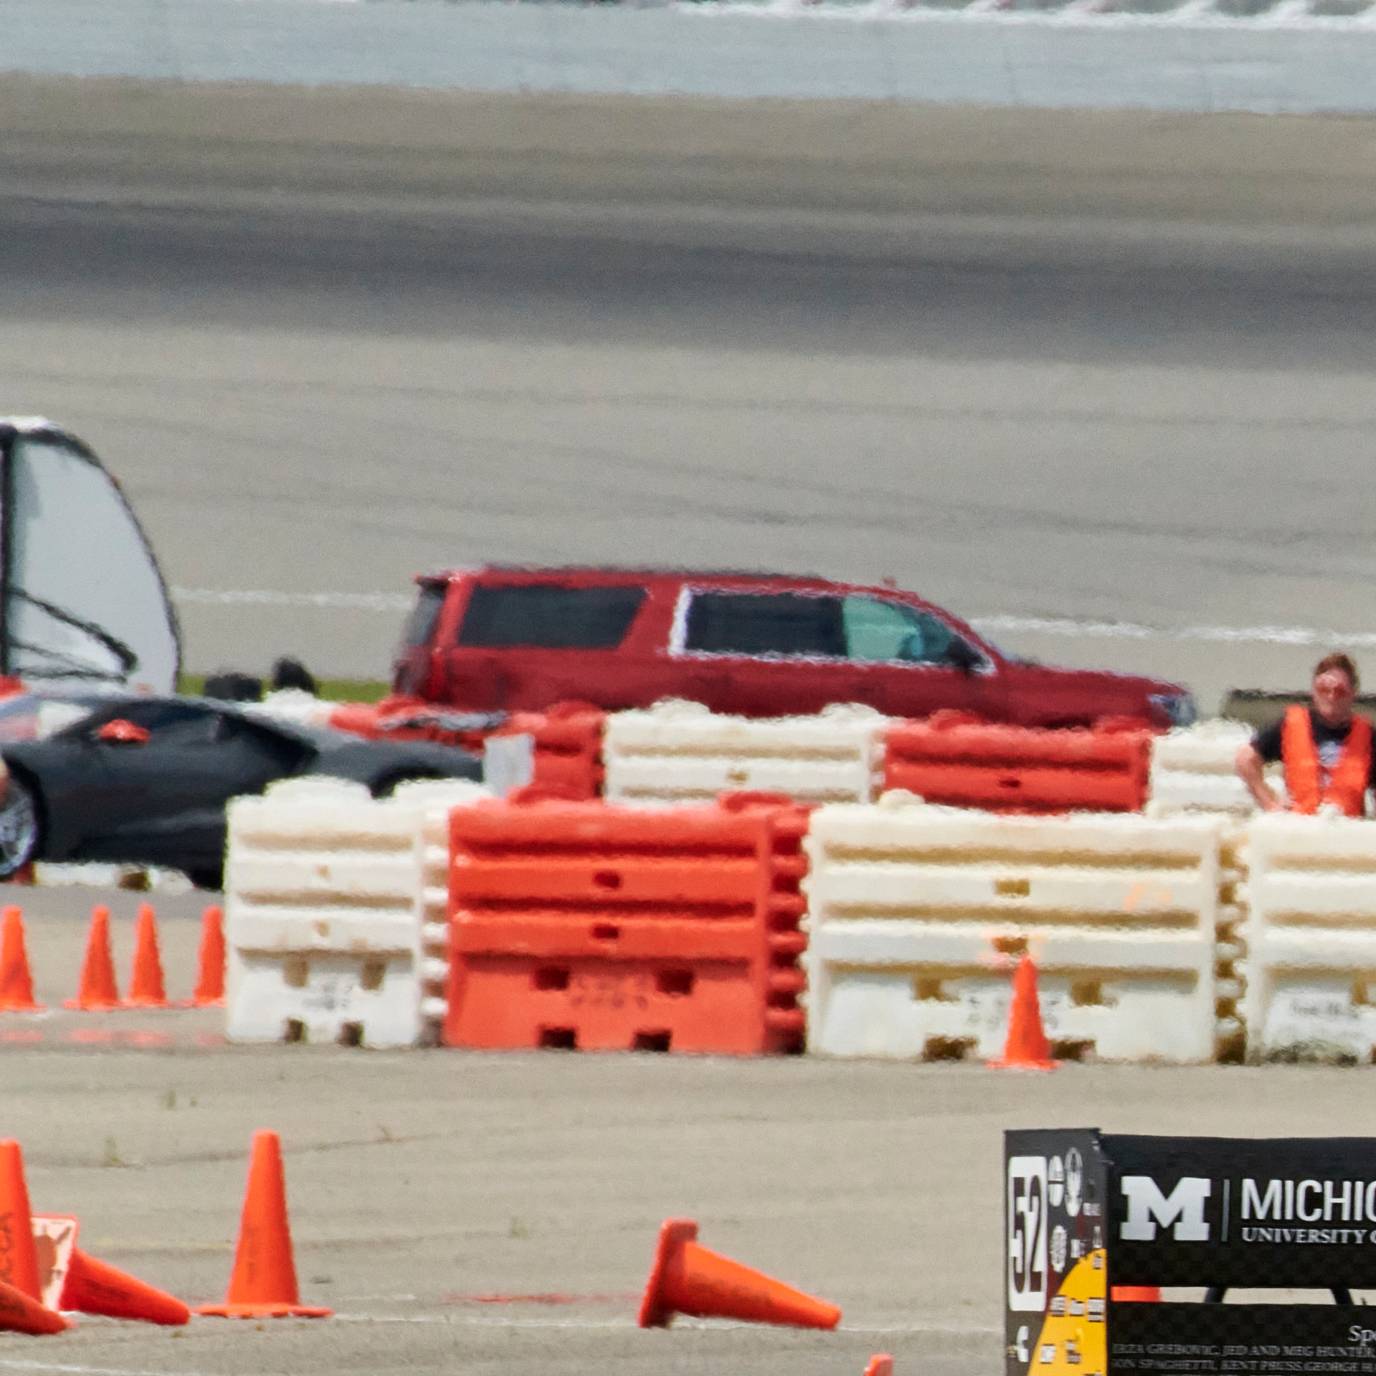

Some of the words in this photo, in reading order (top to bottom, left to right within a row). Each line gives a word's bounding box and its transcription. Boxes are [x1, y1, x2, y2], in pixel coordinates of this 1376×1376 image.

[1010, 1174, 1042, 1294] 52
[1120, 1176, 1212, 1241] M
[1242, 1226, 1367, 1244] UNIVERSITY
